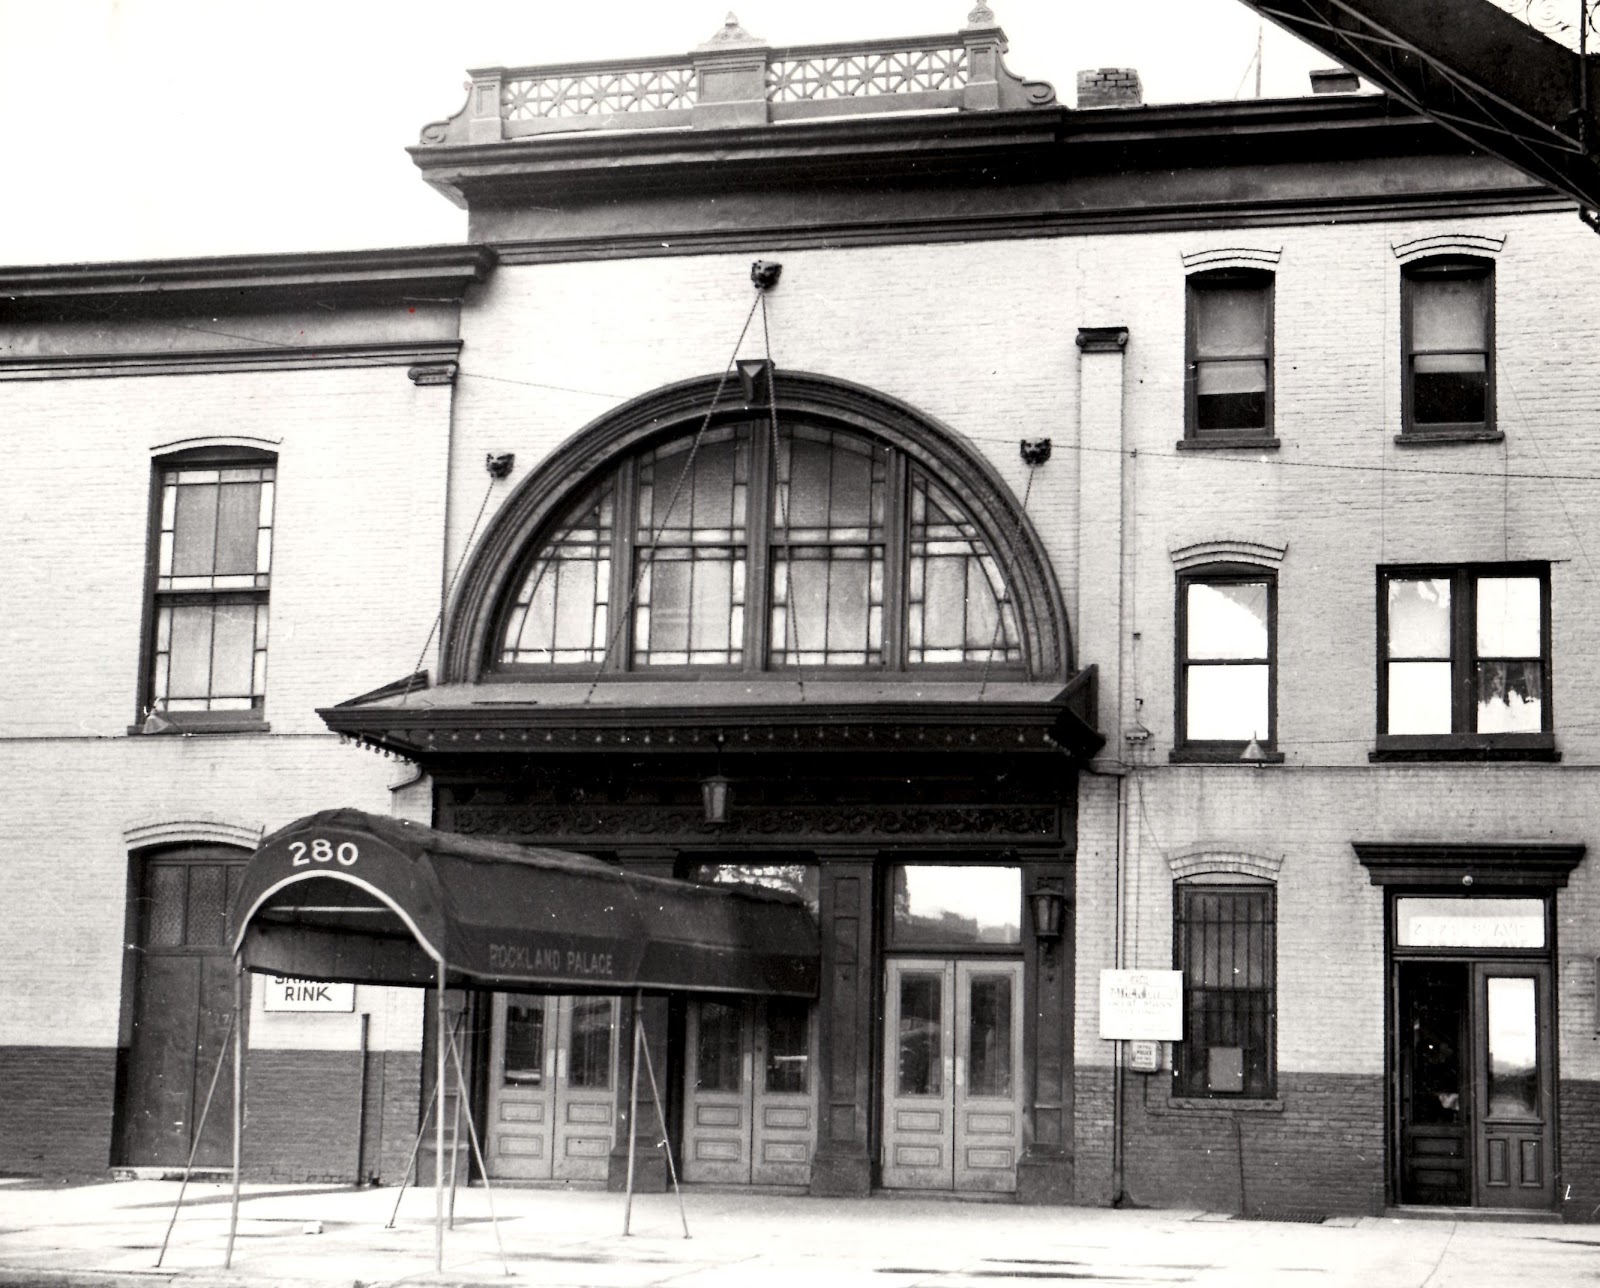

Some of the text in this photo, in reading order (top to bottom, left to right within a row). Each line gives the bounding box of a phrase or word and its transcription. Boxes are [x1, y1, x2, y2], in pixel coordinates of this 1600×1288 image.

[289, 839, 358, 866] 280
[489, 943, 613, 975] ROCKLAND PALACE
[285, 986, 332, 1001] RINK
